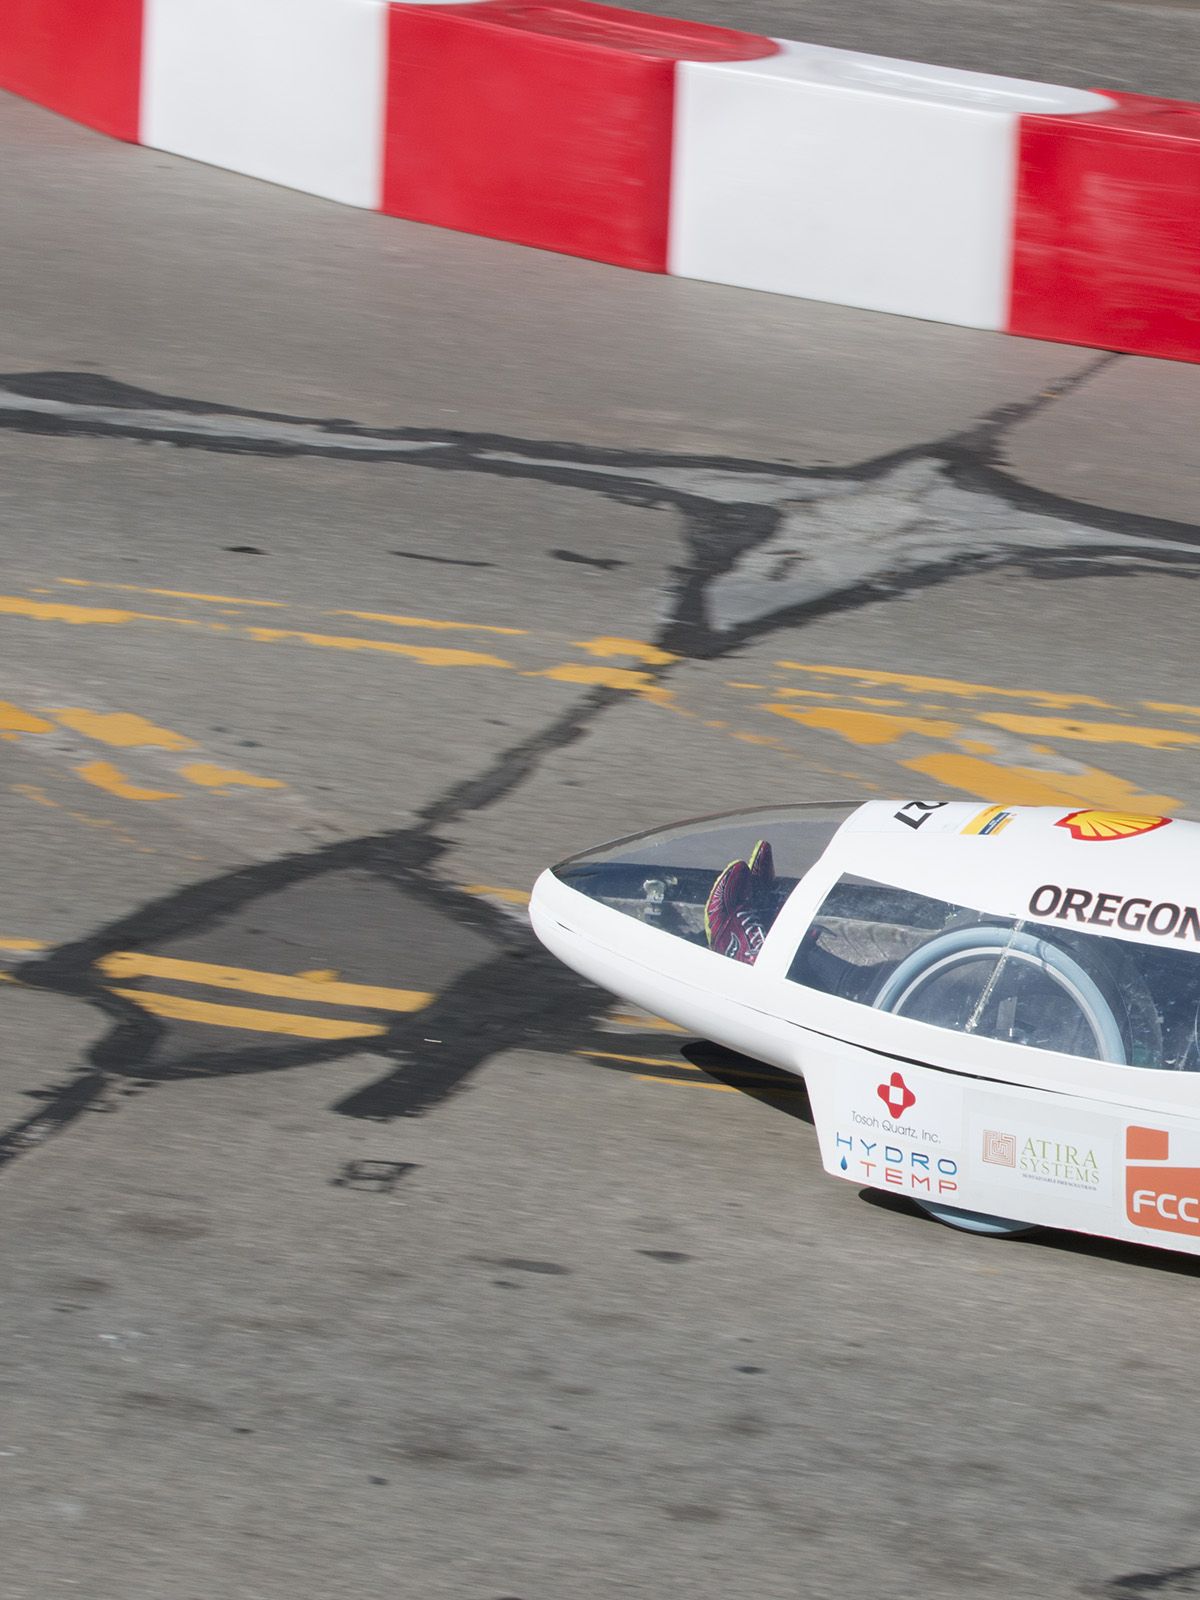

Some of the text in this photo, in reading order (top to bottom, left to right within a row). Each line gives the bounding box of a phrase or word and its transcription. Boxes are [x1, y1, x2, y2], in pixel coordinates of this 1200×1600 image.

[851, 1110, 879, 1128] Tosoh
[921, 1129, 941, 1144] Inc.
[836, 1131, 958, 1176] HYDRO
[1019, 1156, 1100, 1184] SYSTEMS
[1021, 1137, 1098, 1169] ATIRA
[859, 1160, 958, 1194] TEMP
[1132, 1189, 1199, 1224] FCC
